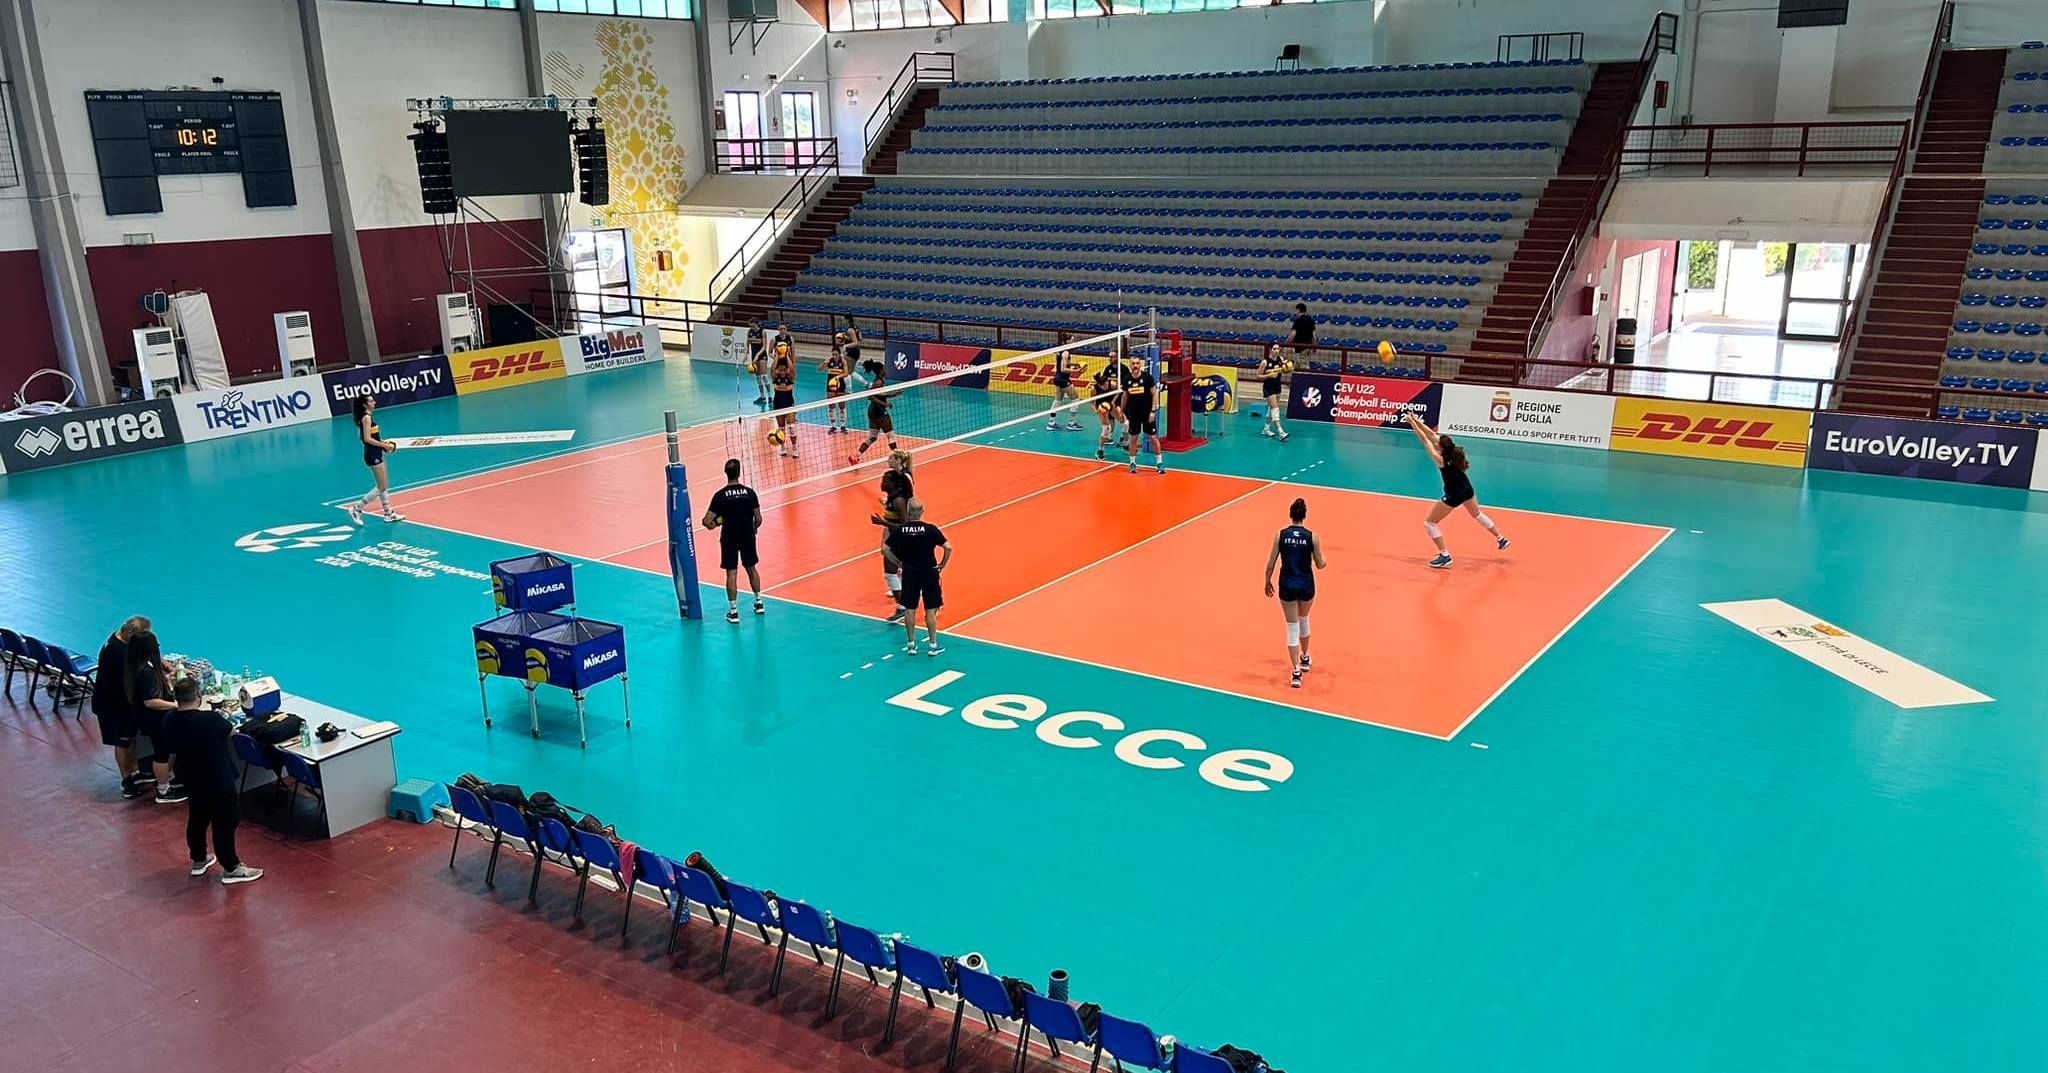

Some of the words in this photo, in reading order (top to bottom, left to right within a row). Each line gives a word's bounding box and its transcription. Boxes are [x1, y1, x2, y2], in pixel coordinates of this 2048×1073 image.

[177, 128, 217, 146] 10:12
[579, 330, 643, 359] BigMat
[469, 350, 554, 382] DHL
[585, 362, 606, 371] HOME
[606, 359, 615, 367] OF
[616, 354, 647, 366] BUILDERS
[332, 367, 442, 401] EuroVolley.TV
[1333, 382, 1355, 393] CEV
[1356, 384, 1375, 395] U22
[196, 390, 312, 430] TRENTINO
[1332, 394, 1379, 408] Volleyball
[1380, 398, 1427, 412] European
[1516, 401, 1562, 414] REGIONE
[1330, 407, 1398, 424] Championship
[1515, 412, 1552, 425] PUGLIA
[1448, 423, 1506, 436] ASSESSORATO
[1507, 429, 1529, 438] ALLO
[1530, 431, 1558, 440] SPORT
[1559, 433, 1577, 442] PER
[1578, 435, 1601, 445] TUTTI
[1635, 411, 1778, 451] DHL
[1825, 430, 2019, 468] EuroVolley.TV
[725, 489, 748, 497] ITALIA
[901, 525, 926, 534] ITALIA
[1284, 537, 1307, 546] ITALIA
[885, 669, 1294, 792] Lecce
